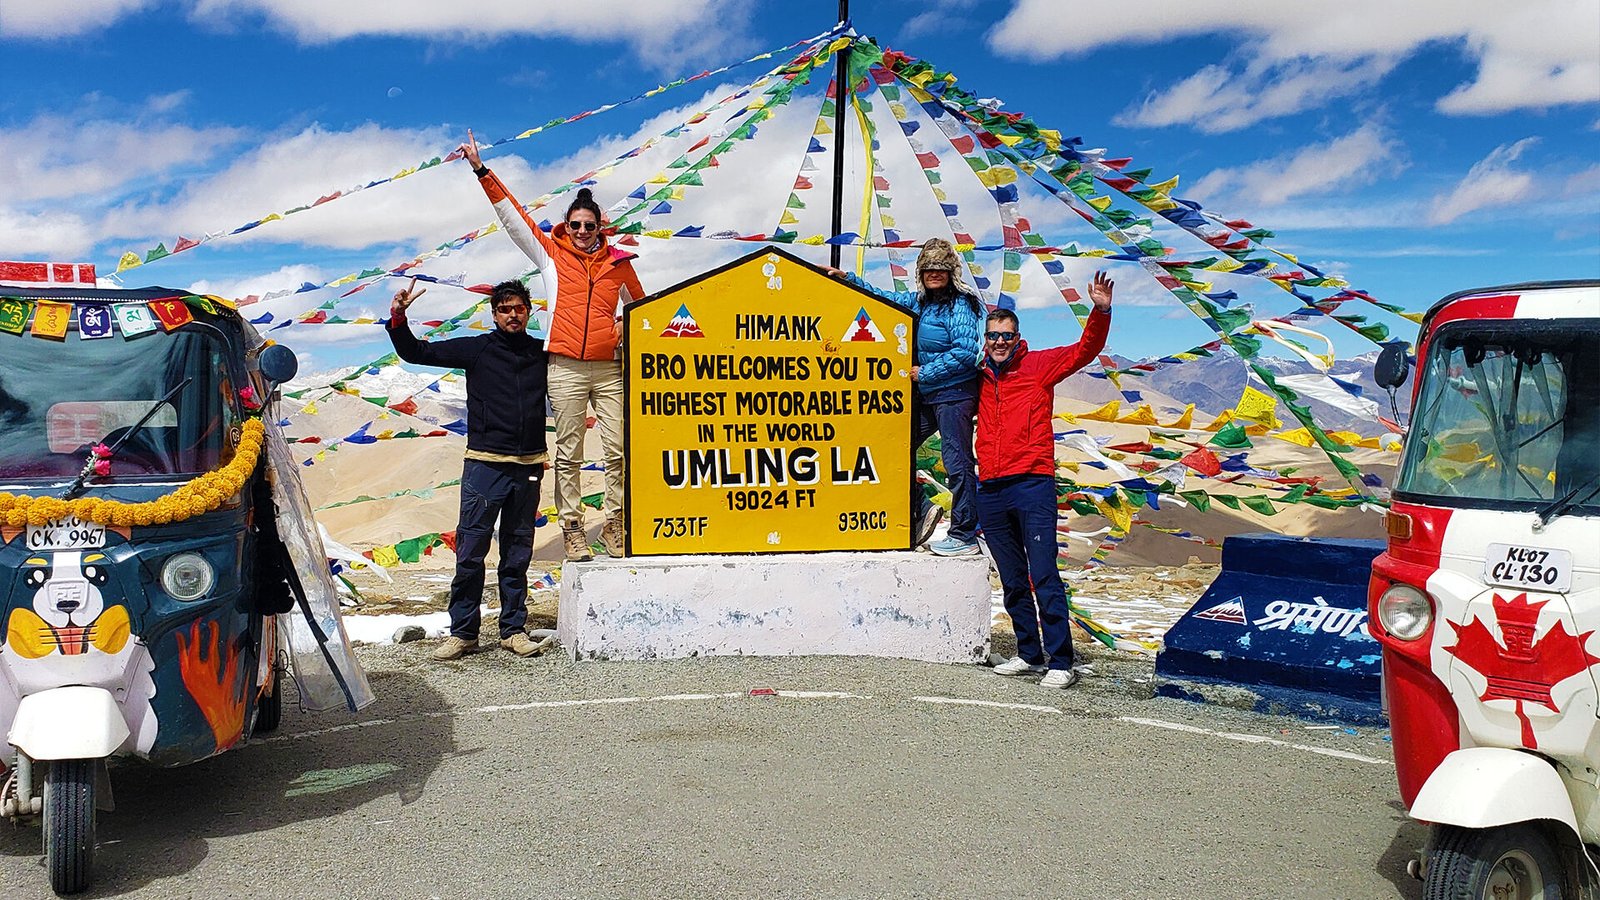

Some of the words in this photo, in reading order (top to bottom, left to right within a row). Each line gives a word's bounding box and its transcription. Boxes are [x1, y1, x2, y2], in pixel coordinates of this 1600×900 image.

[735, 313, 822, 342] HIMANK
[641, 353, 686, 380] BRO
[693, 353, 811, 381] WELCOMES
[816, 356, 858, 381] YOU
[866, 357, 893, 381] TO
[641, 391, 727, 416] HIGHEST
[736, 390, 852, 417] MOTORABLE
[858, 389, 904, 415] PASS
[697, 424, 715, 443] IN
[722, 423, 758, 443] THE
[766, 422, 836, 442] WORLD
[662, 448, 820, 489] UMLING
[830, 446, 881, 485] LA
[726, 490, 789, 511] 19024
[795, 489, 816, 508] FT
[652, 516, 709, 540] 753TF
[838, 510, 888, 533] 93RCC
[69, 528, 104, 547] 9967
